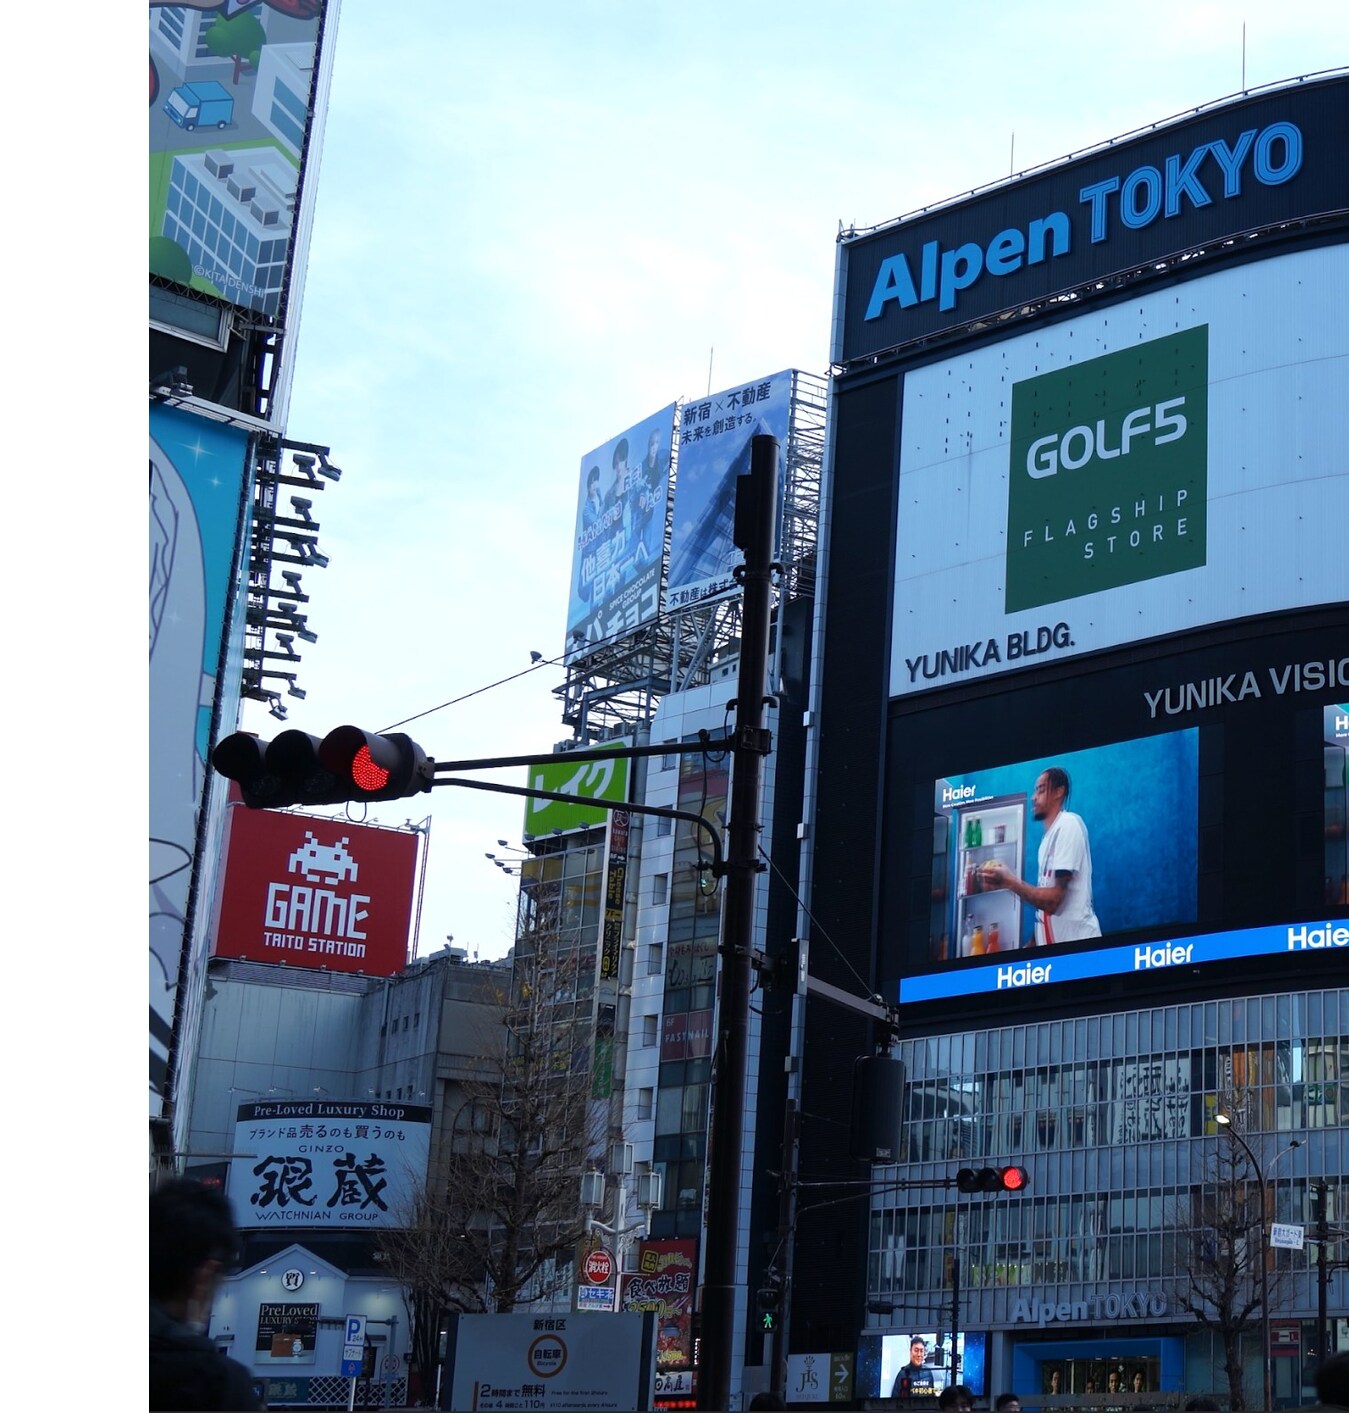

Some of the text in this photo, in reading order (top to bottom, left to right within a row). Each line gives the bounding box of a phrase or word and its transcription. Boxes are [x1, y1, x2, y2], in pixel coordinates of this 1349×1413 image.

[863, 121, 1304, 322] Alpen TOKYO
[228, 277, 265, 299] DENSHI
[1026, 396, 1188, 480] GOLF5
[1024, 489, 1188, 548] FLAGSHIP
[1083, 518, 1187, 559] STORE
[623, 567, 656, 599] CHOCOLATE
[905, 622, 1076, 683] YUNIKA BLDG.
[1144, 671, 1262, 719] YUNIKA
[533, 757, 615, 814] レイク
[942, 784, 976, 803] Haier
[607, 870, 617, 901] Table
[614, 867, 625, 905] Cheese
[265, 882, 371, 940] GAME
[263, 931, 366, 958] TAITO STATION
[997, 961, 1052, 989] Haier
[1134, 942, 1194, 970] Haier
[254, 1103, 405, 1120] Pre-Loved Luxury Shop
[250, 1124, 406, 1141] ブランド品売るのも買うのも
[298, 1145, 344, 1153] GINZO
[250, 1152, 388, 1212] 銀蔵
[339, 1212, 378, 1221] GROUP
[588, 1260, 610, 1274] 消火栓
[627, 1272, 691, 1299] 食べ放題
[260, 1304, 318, 1316] PreLoved
[260, 1316, 293, 1325] LUXURY
[1010, 1290, 1168, 1328] Alpen TOKYO
[347, 1319, 361, 1342] P
[533, 1319, 567, 1331] 新宿区
[533, 1349, 562, 1360] 自転車
